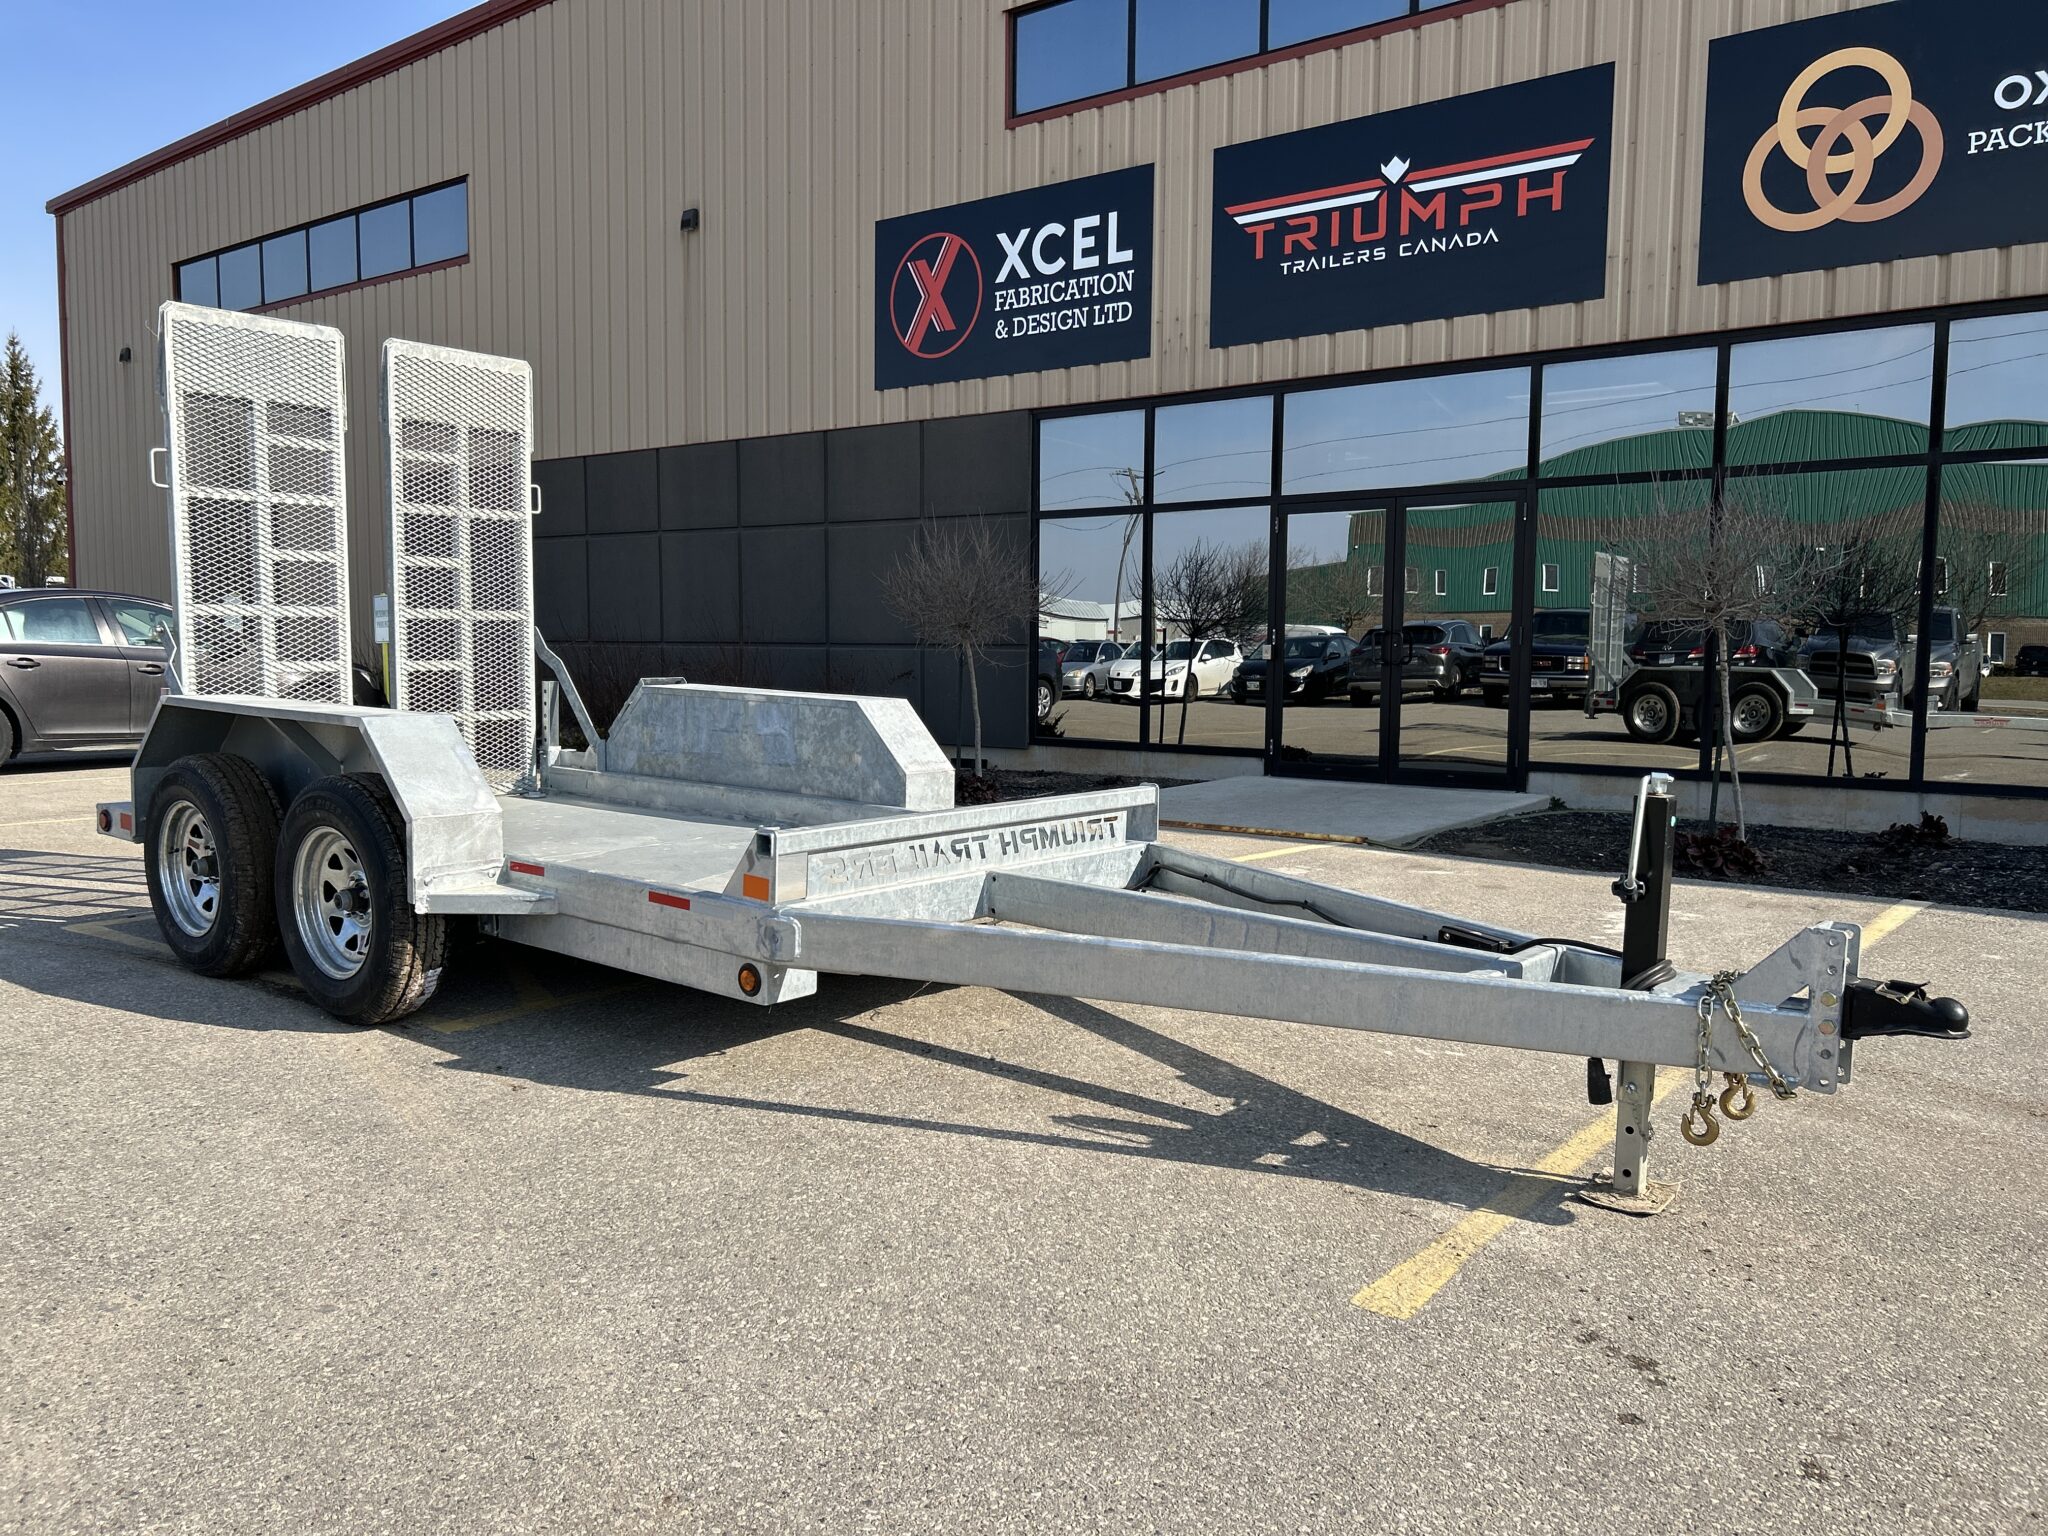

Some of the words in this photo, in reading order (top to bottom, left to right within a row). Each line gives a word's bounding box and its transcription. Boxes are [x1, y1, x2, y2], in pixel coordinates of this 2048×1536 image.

[1243, 170, 1568, 260] TRIUMPH
[994, 210, 1133, 283] XCEL
[1280, 246, 1386, 275] TRAILERS
[1399, 228, 1499, 257] CANADA
[994, 270, 1135, 312] FABRICATION
[994, 319, 1009, 340] &
[1012, 306, 1090, 338] DESIGN
[1092, 301, 1133, 327] LTD
